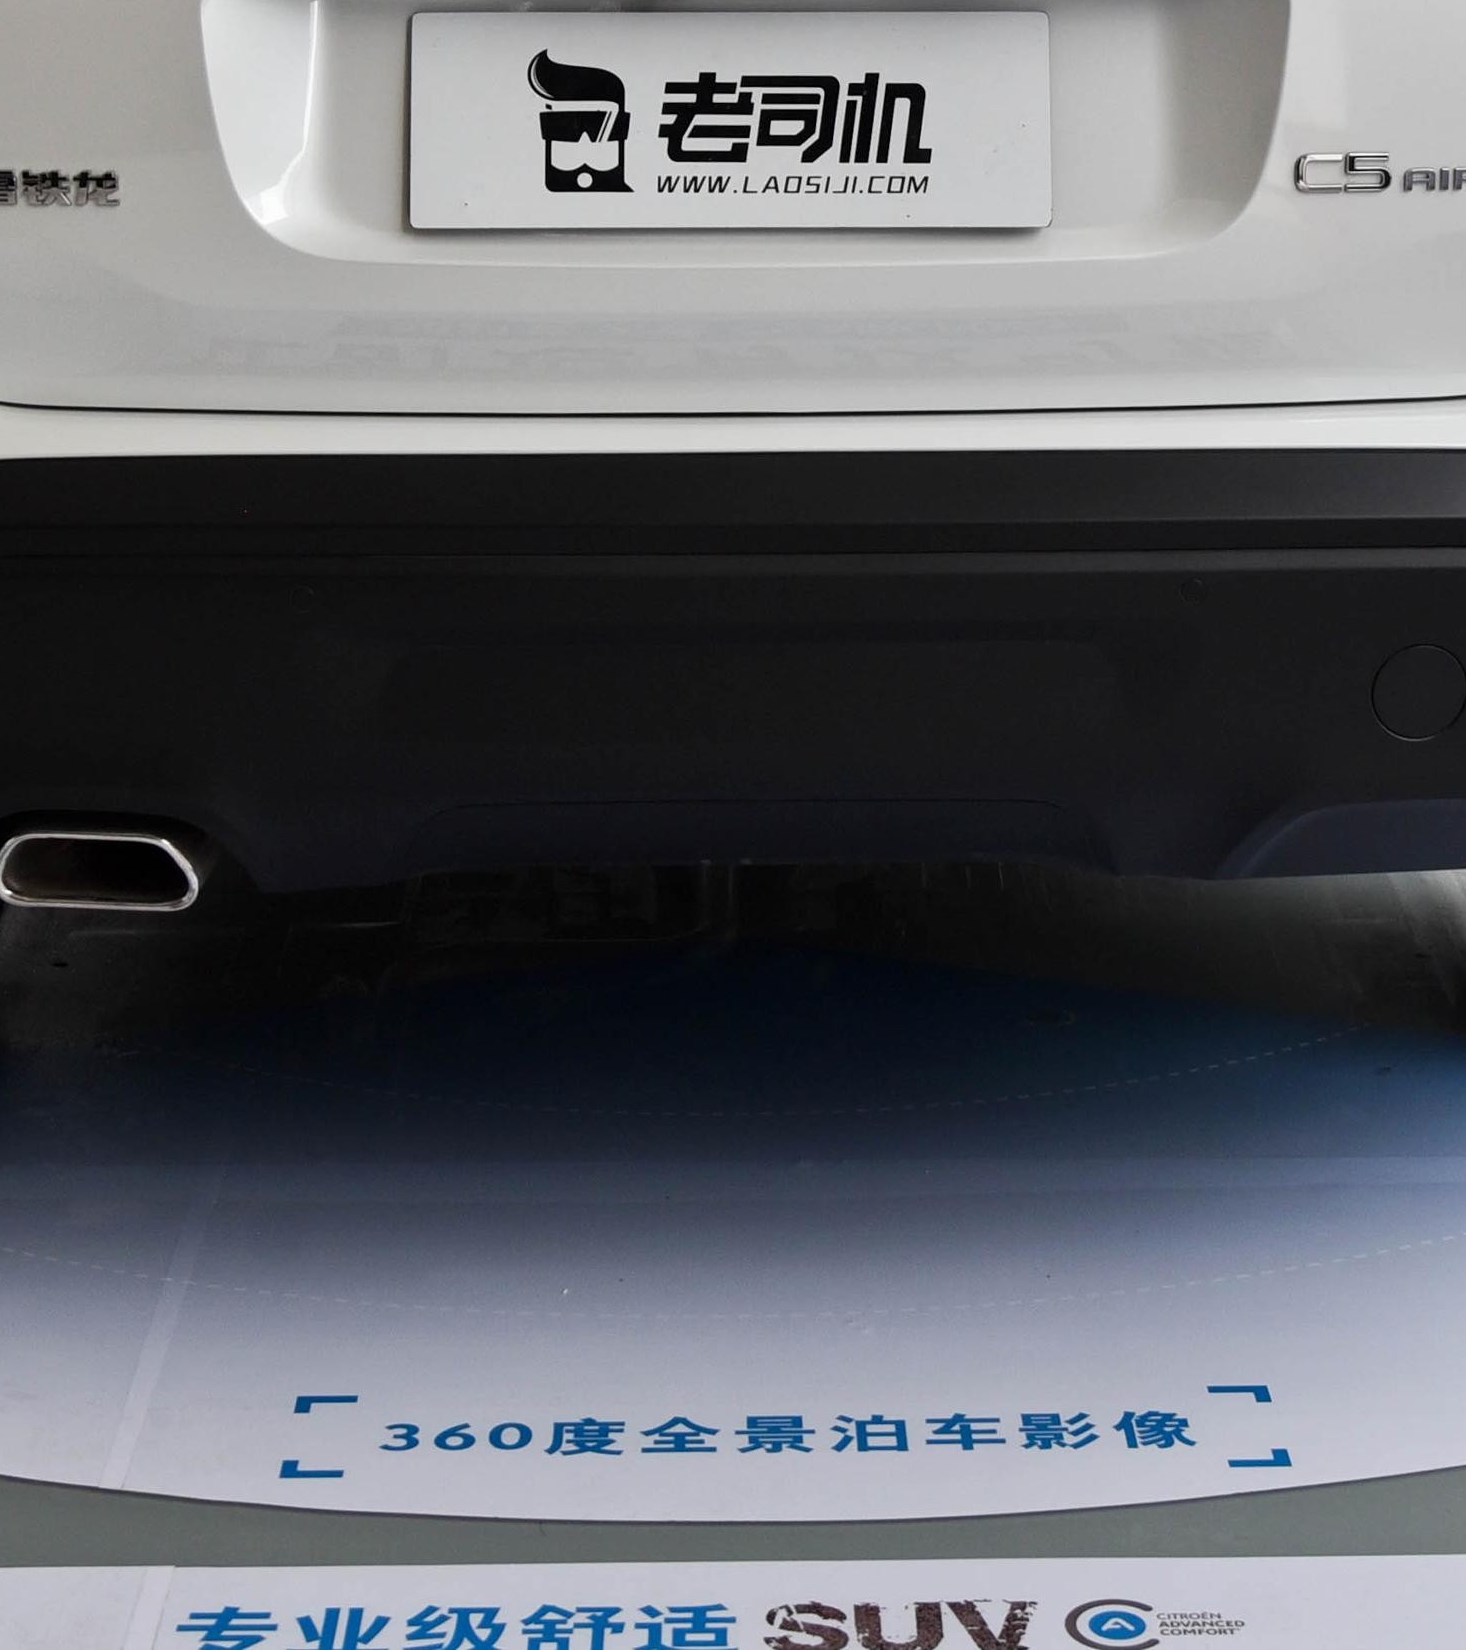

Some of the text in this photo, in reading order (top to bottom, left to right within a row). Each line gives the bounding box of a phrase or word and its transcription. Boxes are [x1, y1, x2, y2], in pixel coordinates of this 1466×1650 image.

[658, 72, 933, 165] 老司机
[656, 174, 930, 195] WWW.LAOSIJI.COM
[1294, 151, 1392, 193] C5
[378, 1407, 1199, 1458] 360度全景泊车影像
[764, 1598, 1039, 1650] SUV
[1158, 1619, 1246, 1628] ADVANCED
